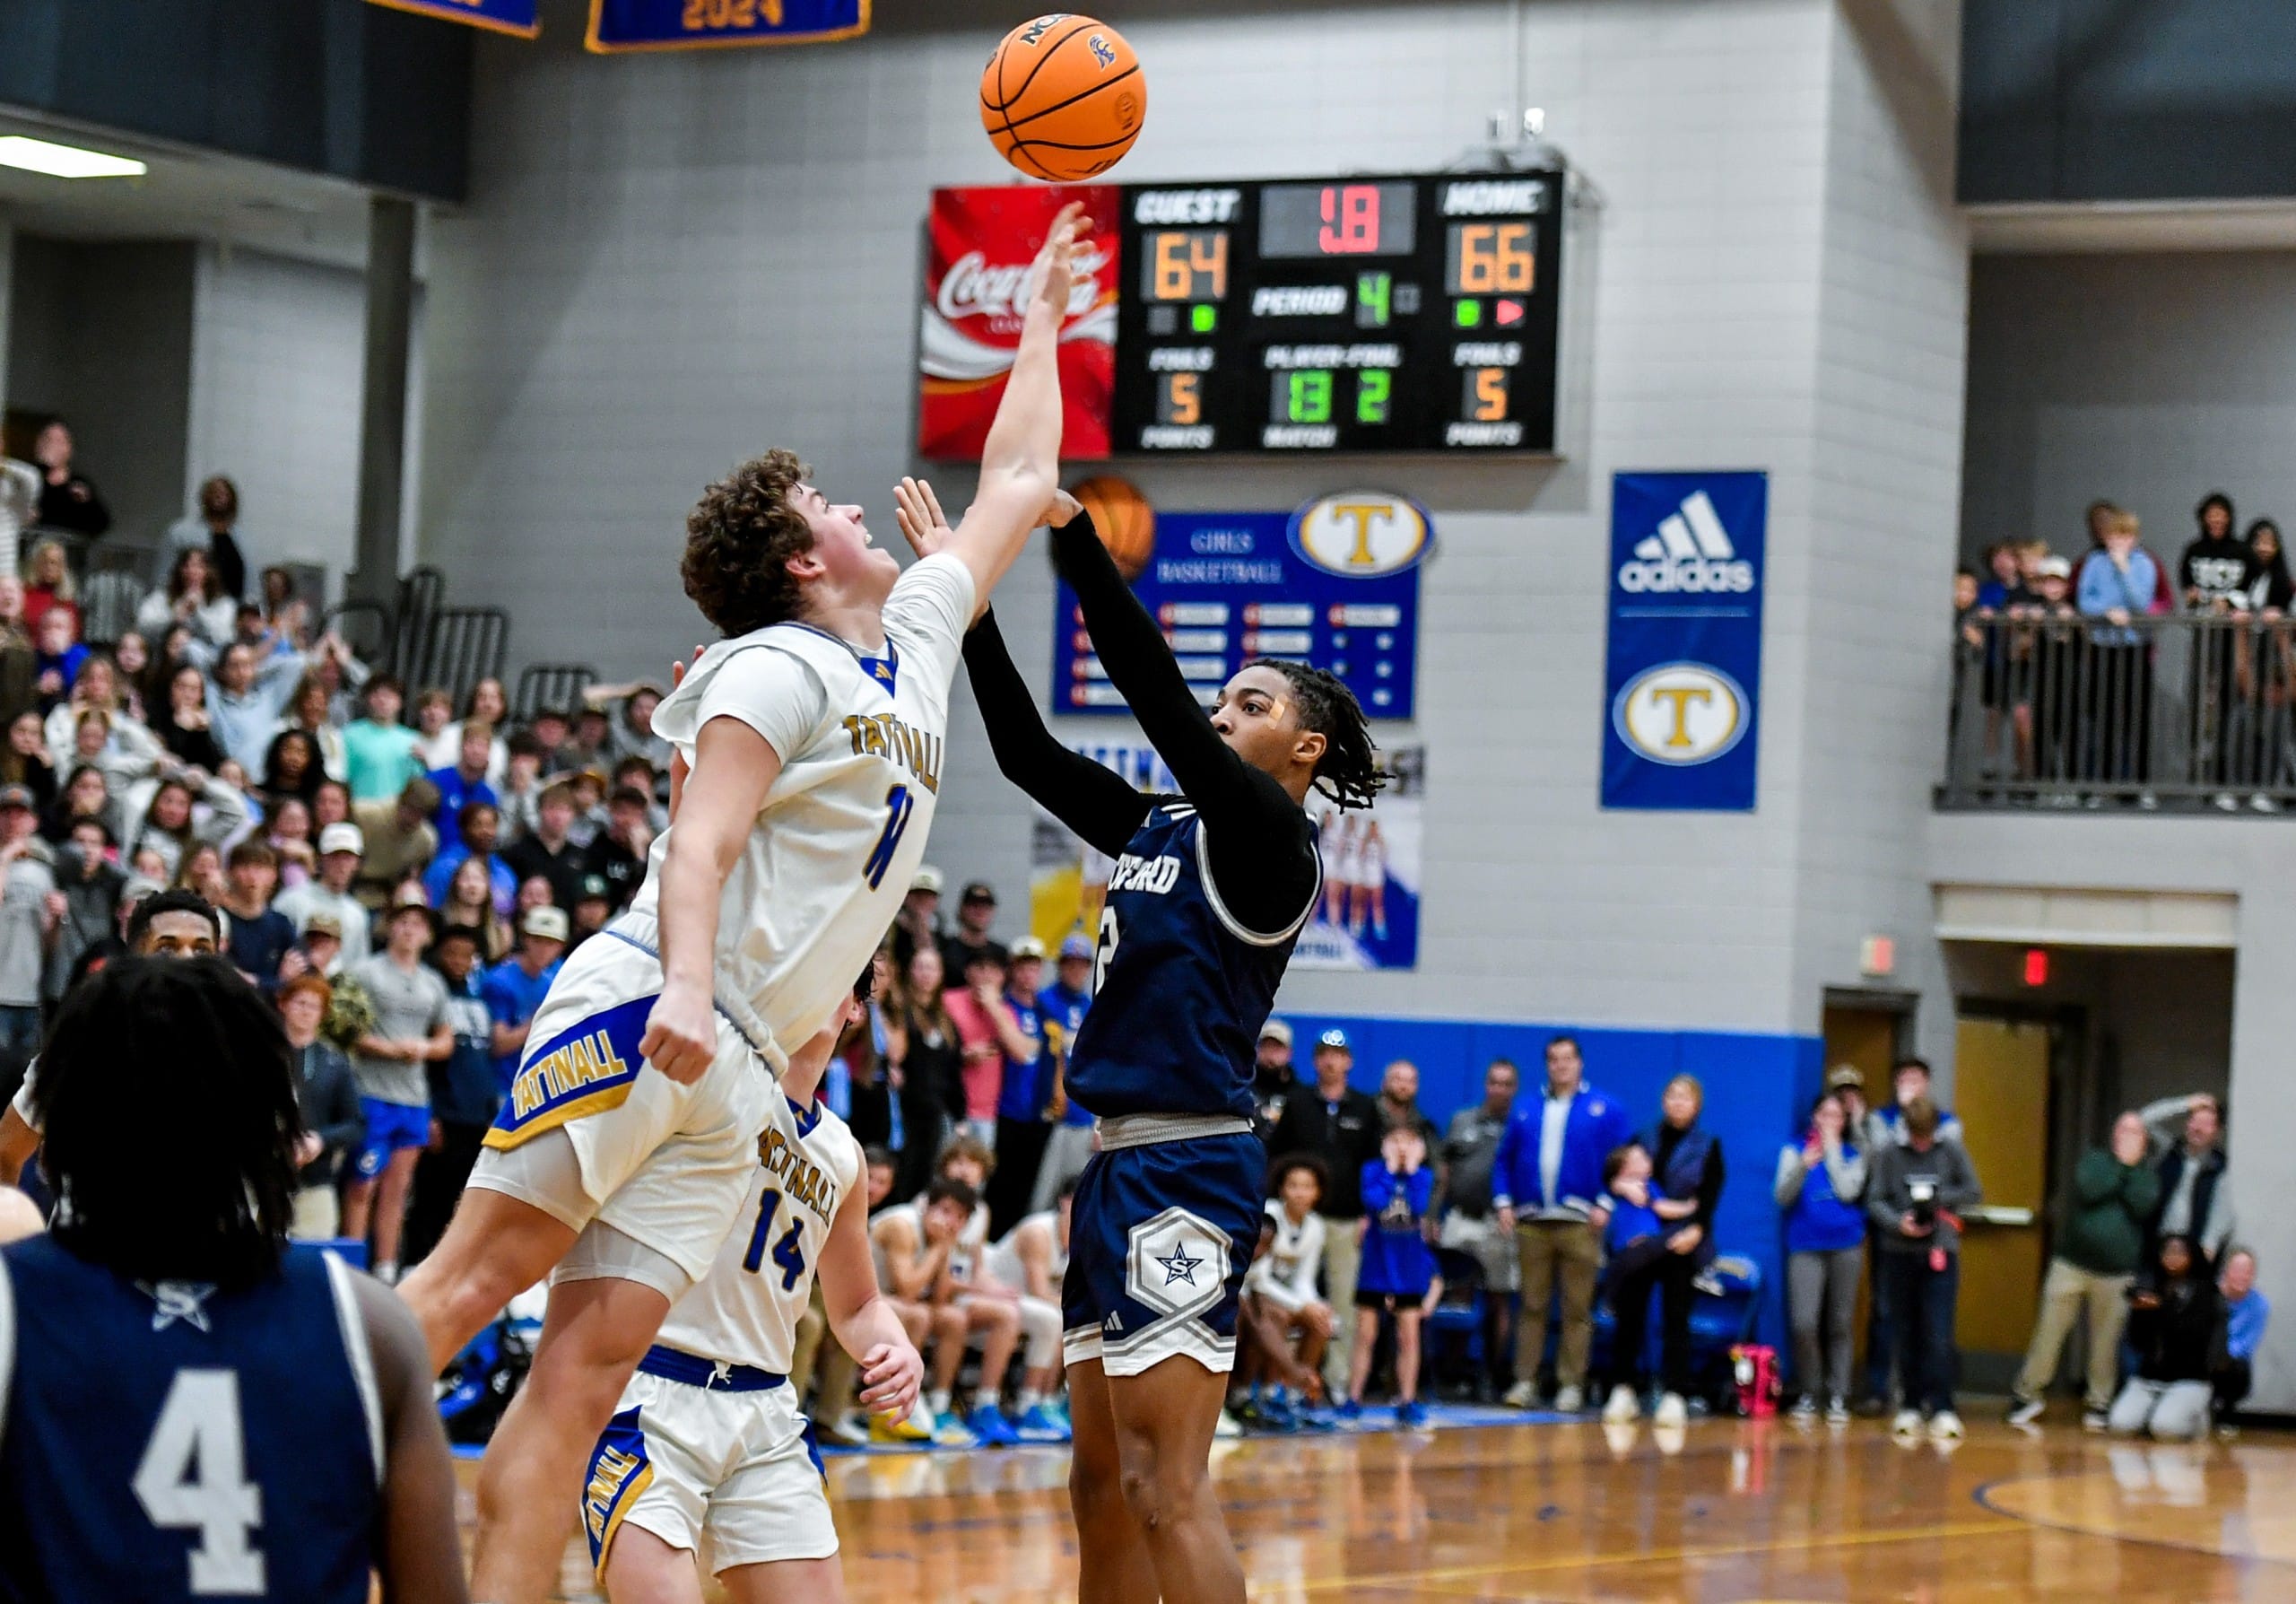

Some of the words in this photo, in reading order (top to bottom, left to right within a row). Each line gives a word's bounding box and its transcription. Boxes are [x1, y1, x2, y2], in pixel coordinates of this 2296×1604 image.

[1019, 13, 1073, 45] NC
[1135, 188, 1240, 223] GUEST
[1443, 181, 1544, 215] HOME
[1155, 232, 1228, 299] 64
[1461, 225, 1535, 292] 66
[1253, 285, 1348, 316] PERIOD
[1358, 273, 1390, 326] 4
[1170, 371, 1200, 424] 5
[1357, 369, 1390, 423] 2
[1475, 367, 1507, 421] 5
[1191, 530, 1254, 554] GIRLS
[1334, 505, 1393, 565] T
[1157, 559, 1283, 584] BASKETBALL
[1618, 556, 1755, 593] adidas
[1652, 688, 1711, 747] T
[511, 1029, 628, 1121] TATTNALL
[744, 1187, 805, 1293] 14
[131, 1368, 265, 1595] 4
